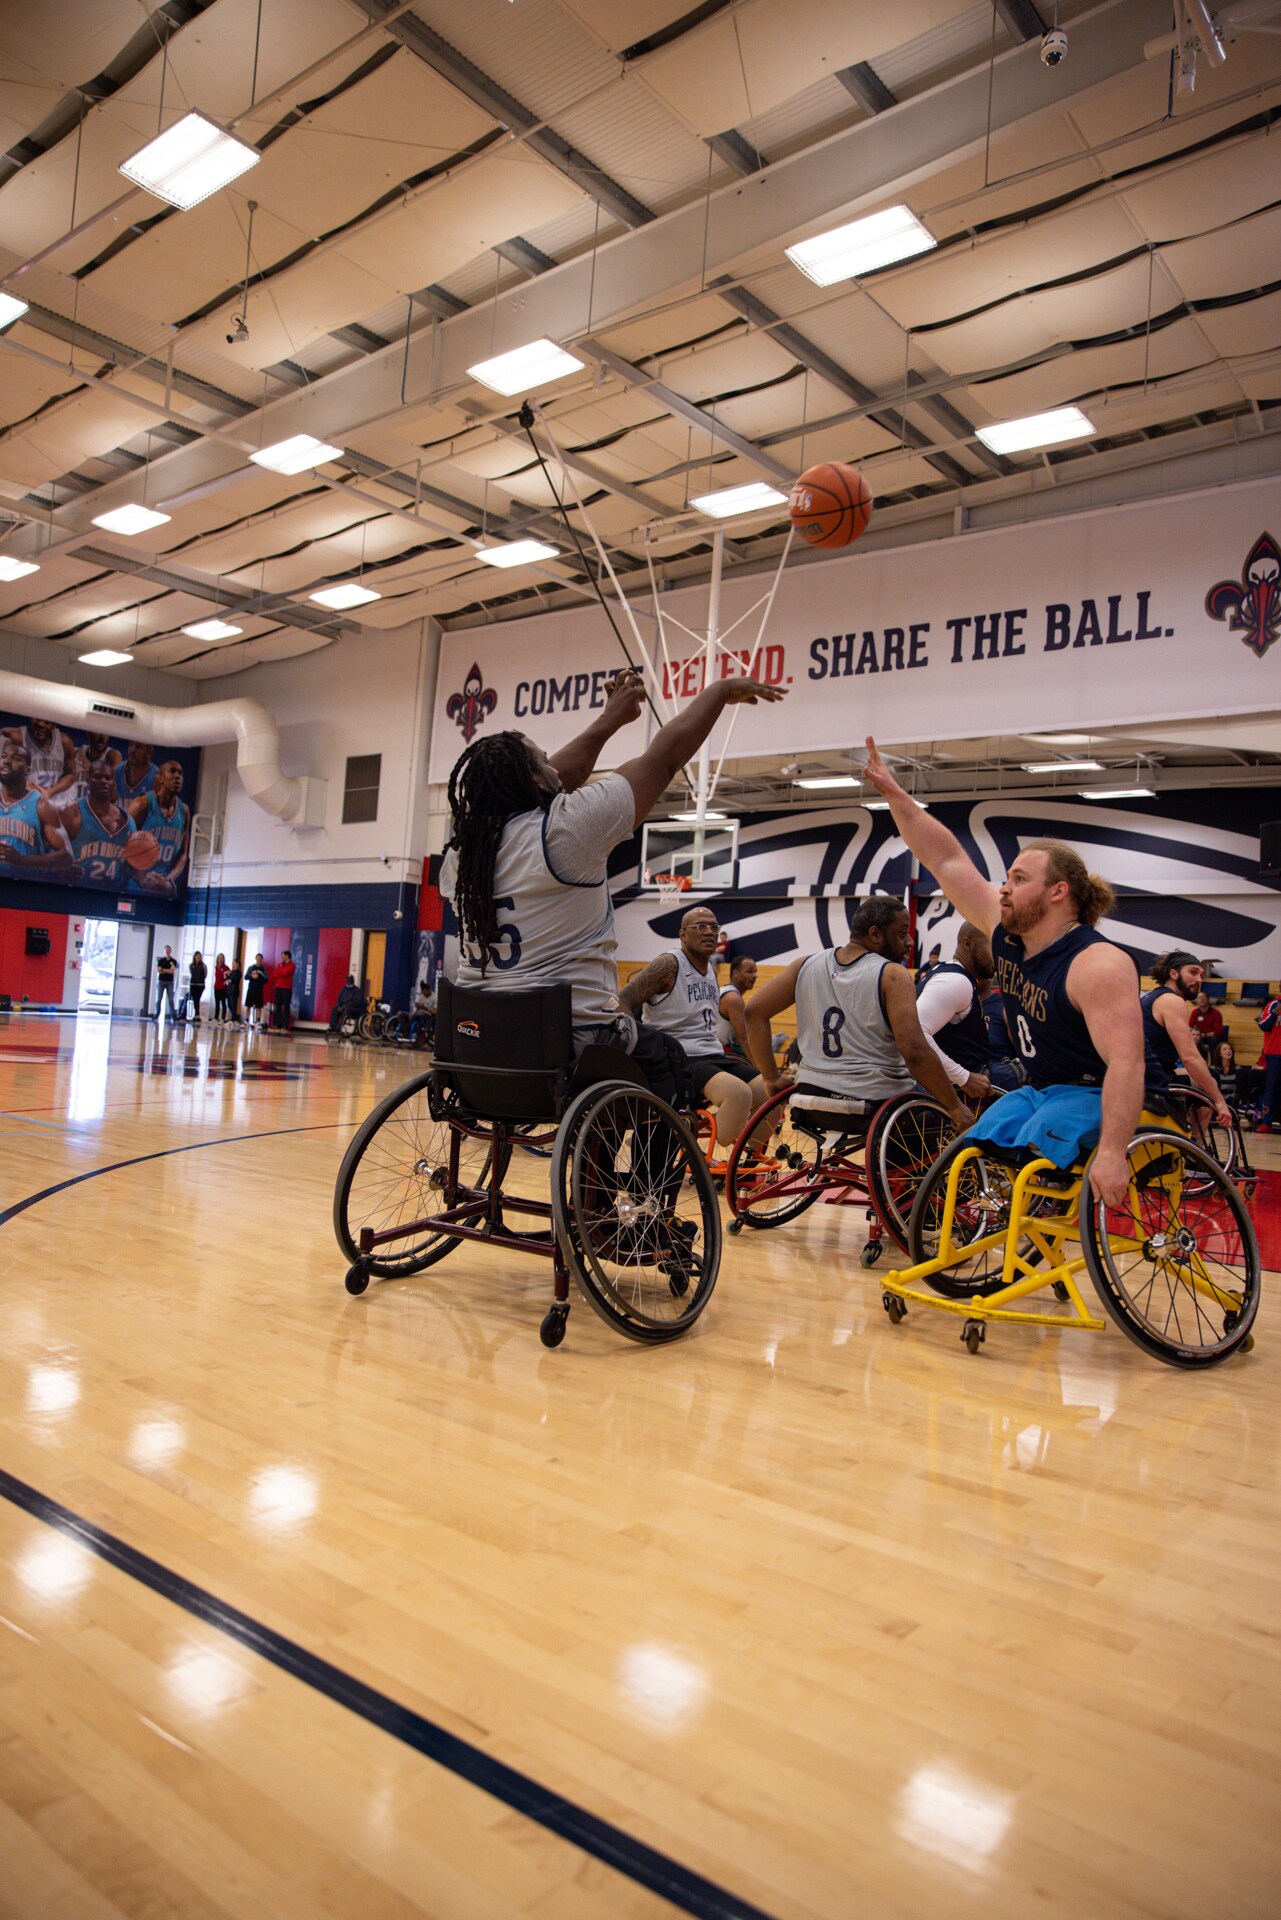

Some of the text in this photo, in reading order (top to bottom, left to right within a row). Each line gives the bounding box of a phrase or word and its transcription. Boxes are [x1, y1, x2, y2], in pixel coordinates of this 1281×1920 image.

[514, 665, 644, 717] COMPE
[808, 623, 931, 681] SHARE
[946, 608, 1028, 664] THE
[1043, 590, 1175, 653] BALL.
[90, 860, 117, 880] 24
[457, 1024, 481, 1038] QUICKIE
[822, 1006, 846, 1058] 8
[1017, 1015, 1037, 1059] 0
